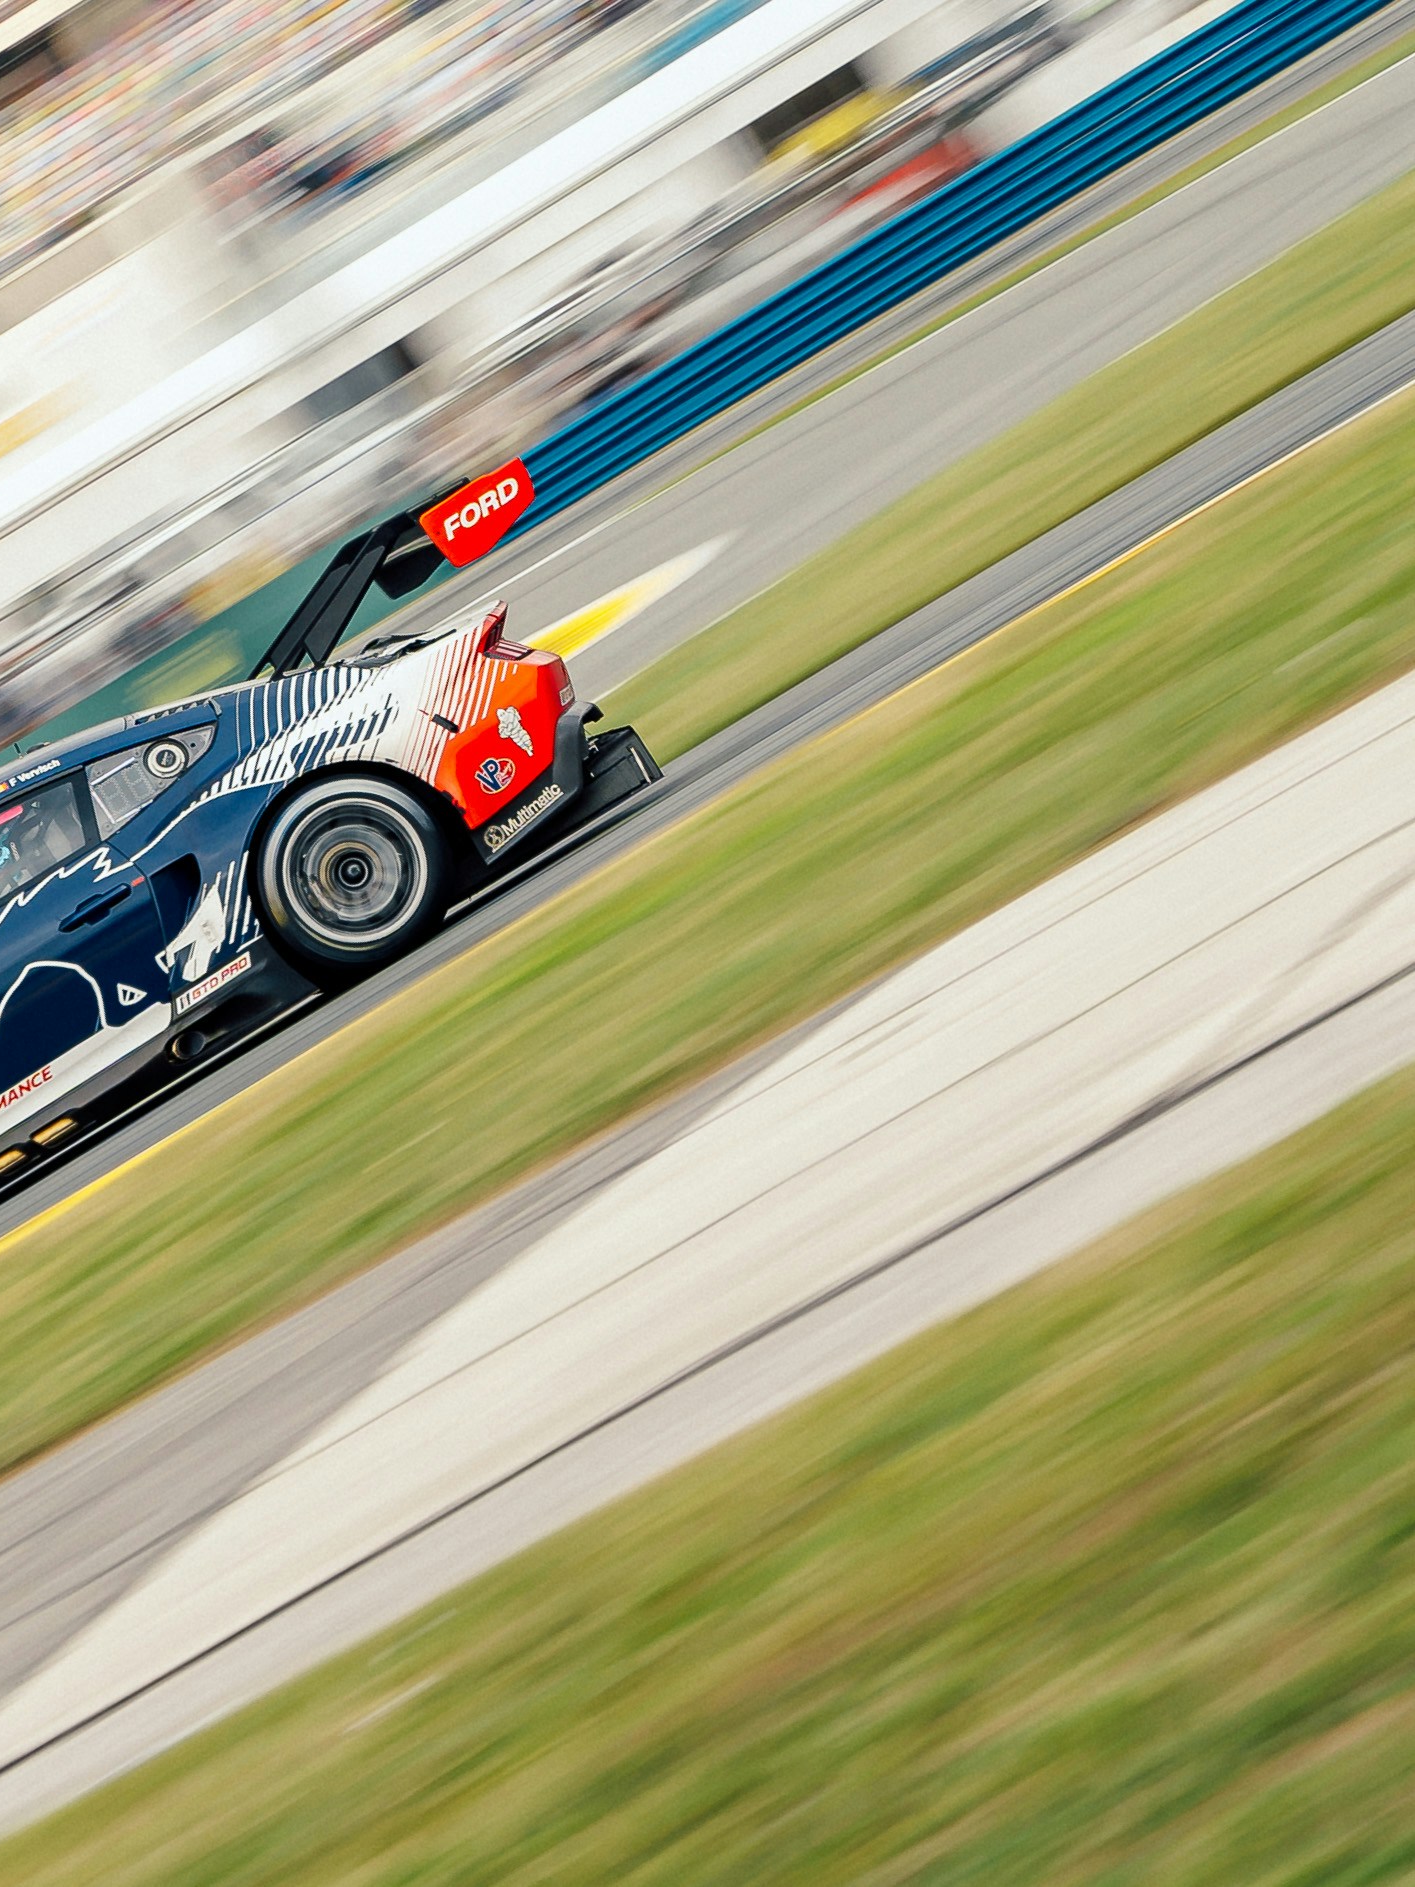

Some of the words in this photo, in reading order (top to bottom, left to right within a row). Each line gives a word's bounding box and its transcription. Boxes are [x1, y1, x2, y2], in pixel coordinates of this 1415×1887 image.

[444, 477, 519, 541] FORD
[8, 777, 18, 788] F
[16, 758, 62, 784] Vervisch
[474, 757, 500, 792] VP
[501, 784, 561, 837] Multimatic
[192, 976, 219, 1000] GTD
[221, 957, 248, 982] PRO
